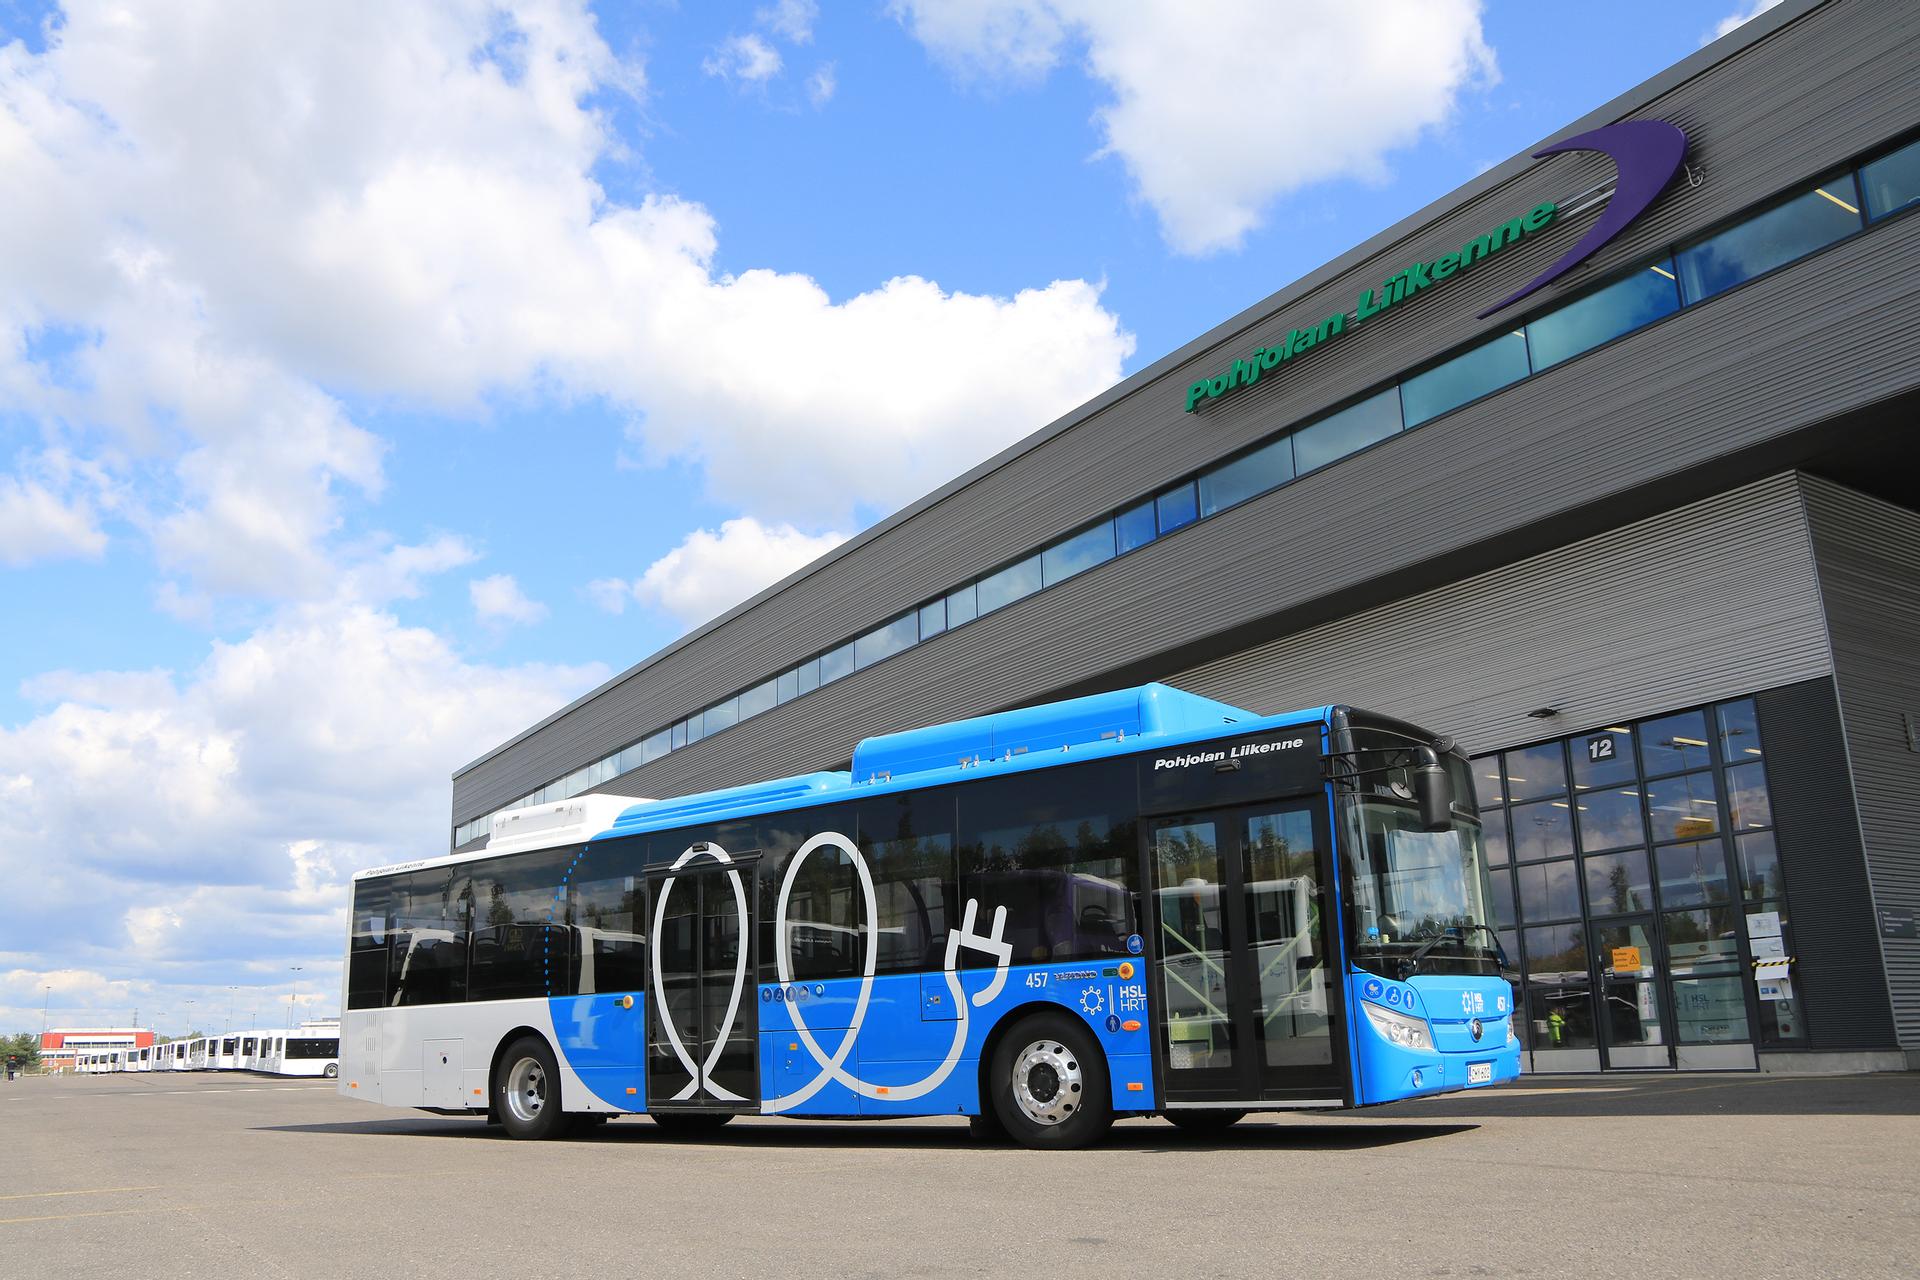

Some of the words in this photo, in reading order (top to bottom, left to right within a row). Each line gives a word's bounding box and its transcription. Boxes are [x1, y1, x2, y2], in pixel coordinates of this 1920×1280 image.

[1186, 312, 1346, 412] Pohjolan
[1357, 200, 1558, 321] Liikenne
[1154, 752, 1225, 770] Pohjolan
[1230, 738, 1304, 758] Liikenne
[1590, 739, 1611, 758] 12
[1026, 972, 1048, 988] 457
[1120, 985, 1146, 998] HSL
[1120, 997, 1147, 1011] HRT
